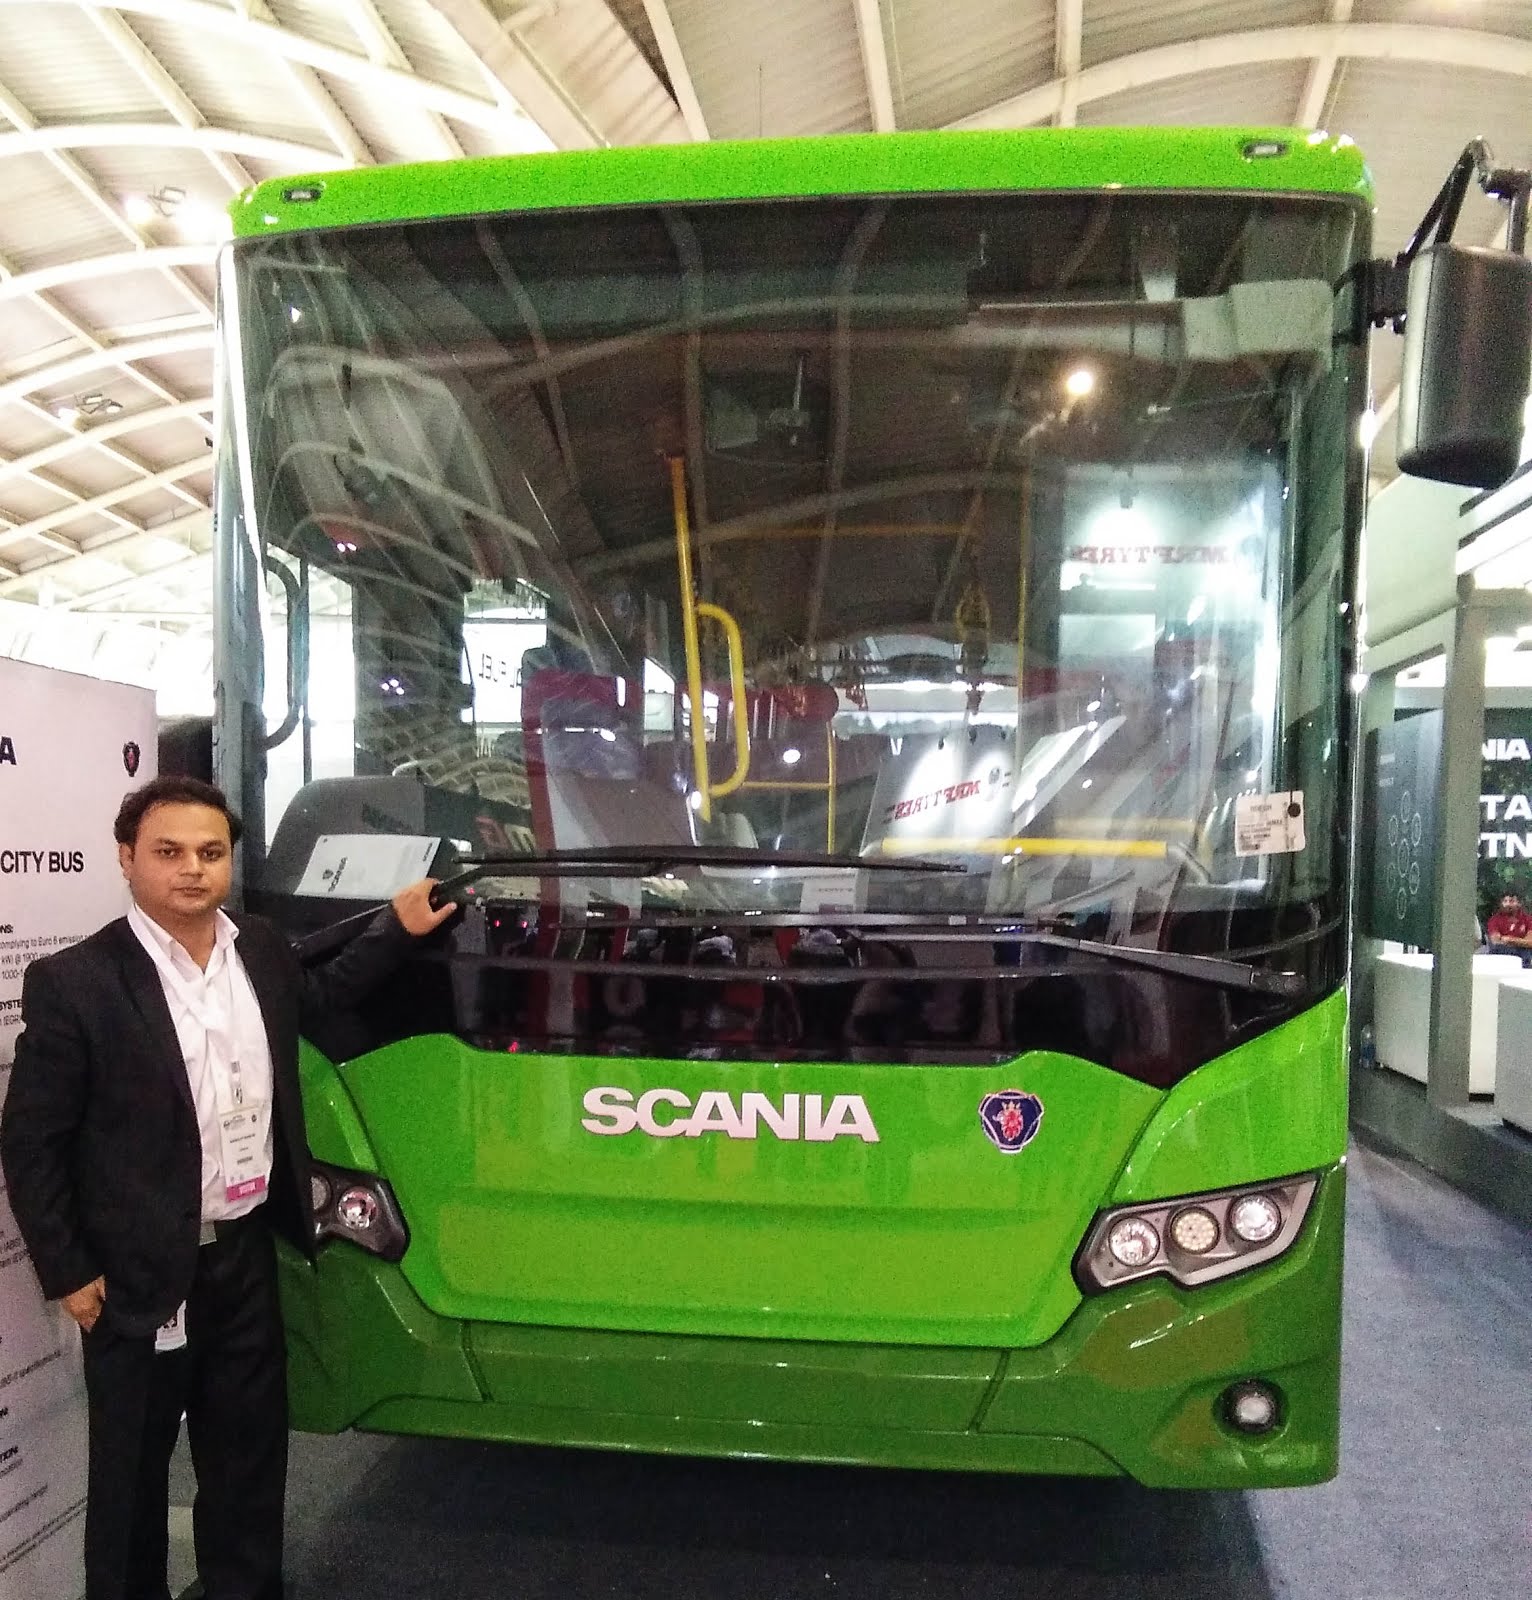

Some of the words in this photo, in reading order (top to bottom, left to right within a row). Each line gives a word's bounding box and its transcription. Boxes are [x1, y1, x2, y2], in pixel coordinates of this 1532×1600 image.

[1477, 832, 1532, 858] TN
[0, 849, 45, 874] CITY
[48, 851, 85, 874] BUS
[580, 1086, 880, 1143] SCANIA
